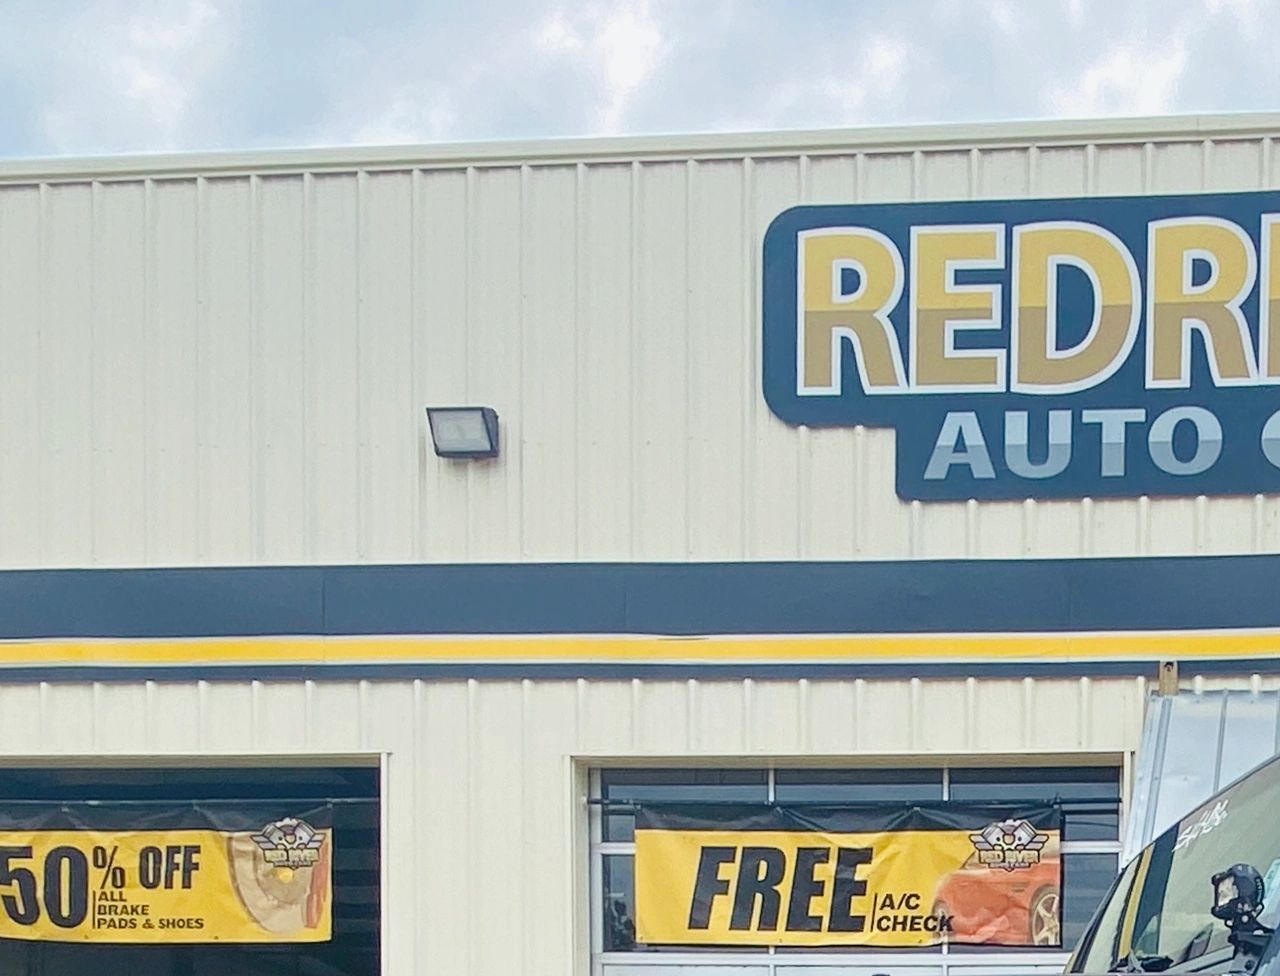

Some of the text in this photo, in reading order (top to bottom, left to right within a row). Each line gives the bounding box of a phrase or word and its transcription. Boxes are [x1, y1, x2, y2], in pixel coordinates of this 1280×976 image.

[924, 404, 1226, 481] AUTO
[139, 845, 201, 889] OFF
[98, 891, 127, 902] ALL
[688, 846, 873, 932] FREE
[97, 904, 150, 916] BRAKE
[880, 893, 921, 911] A/C
[97, 918, 205, 929] PADS & SHOES
[877, 915, 955, 932] CHECK
